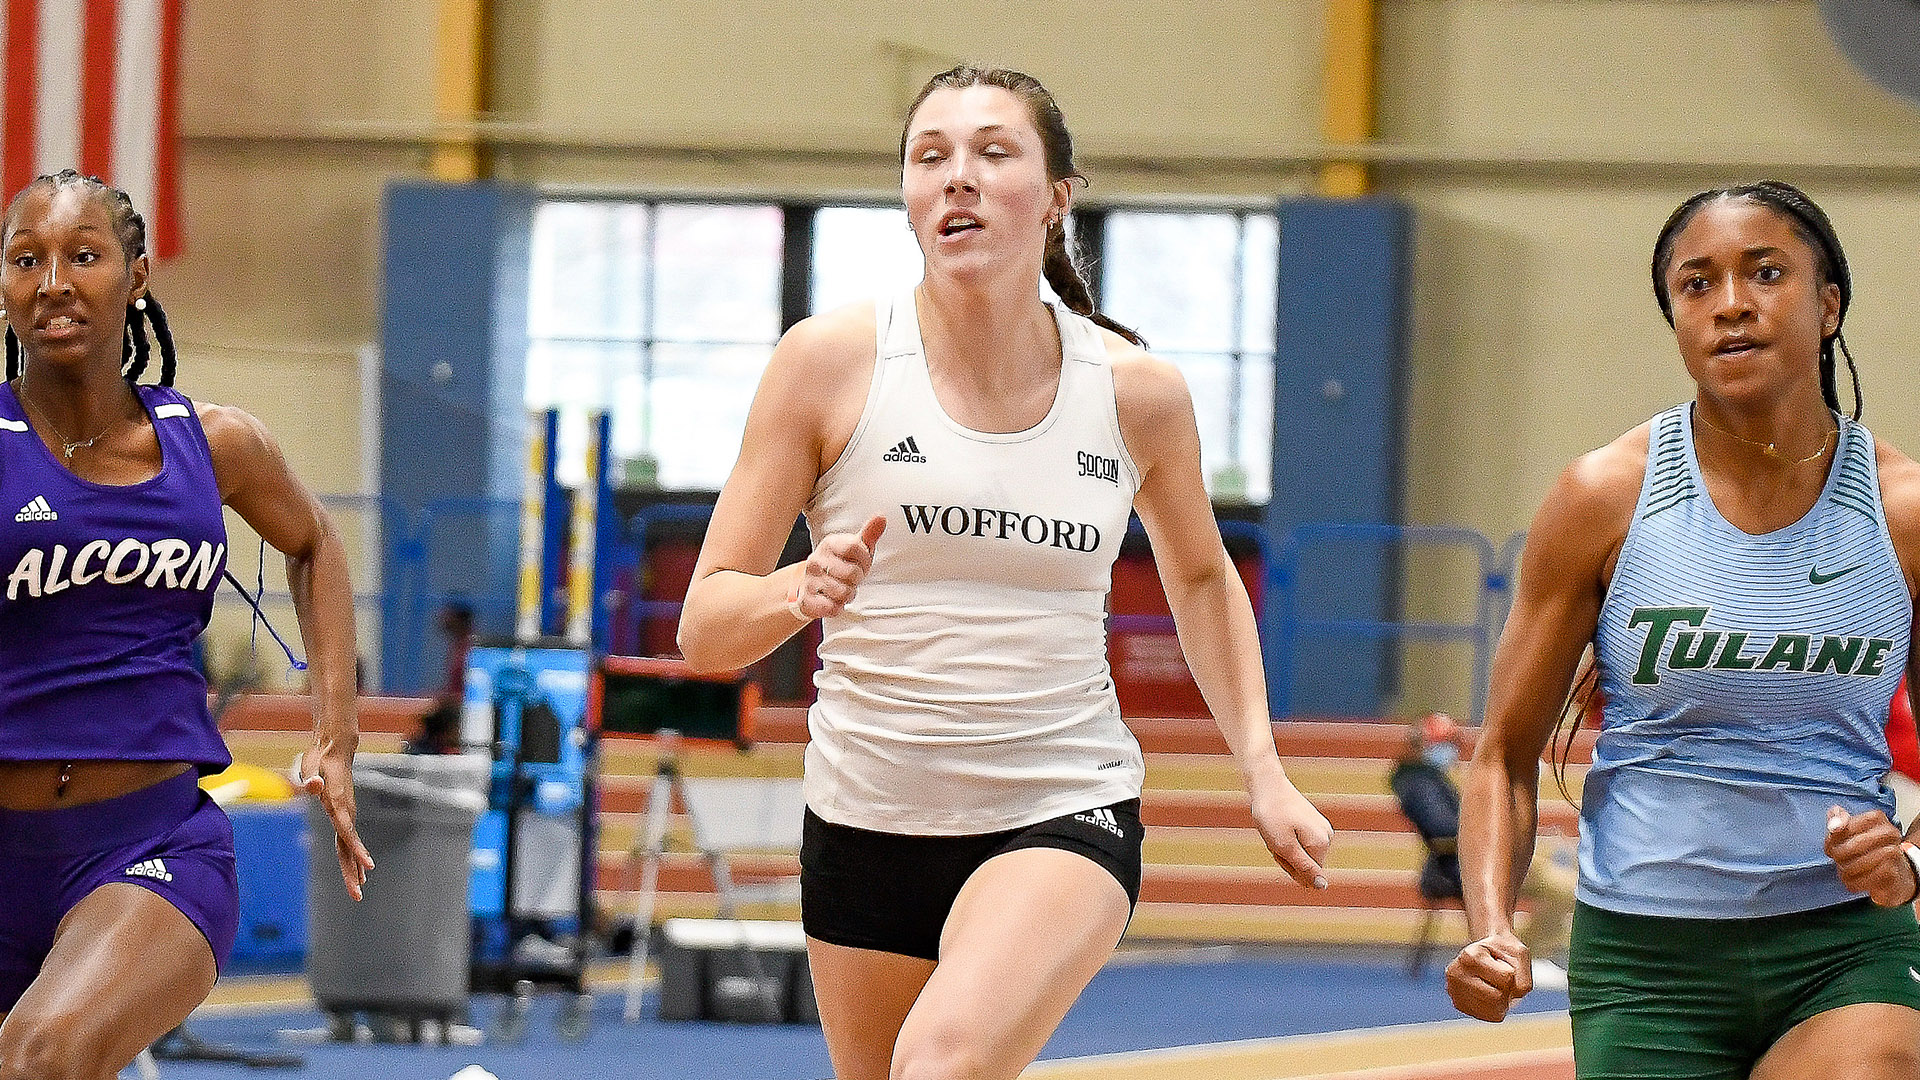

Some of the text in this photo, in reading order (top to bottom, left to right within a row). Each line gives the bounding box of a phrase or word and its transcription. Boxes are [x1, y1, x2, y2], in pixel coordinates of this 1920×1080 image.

[882, 451, 927, 464] adidas
[15, 510, 58, 522] adidas
[900, 504, 1101, 553] WOFFORD
[7, 538, 225, 600] ALCORN
[1626, 606, 1894, 686] TULANE
[1074, 814, 1124, 838] adidas
[125, 866, 173, 882] adidas
